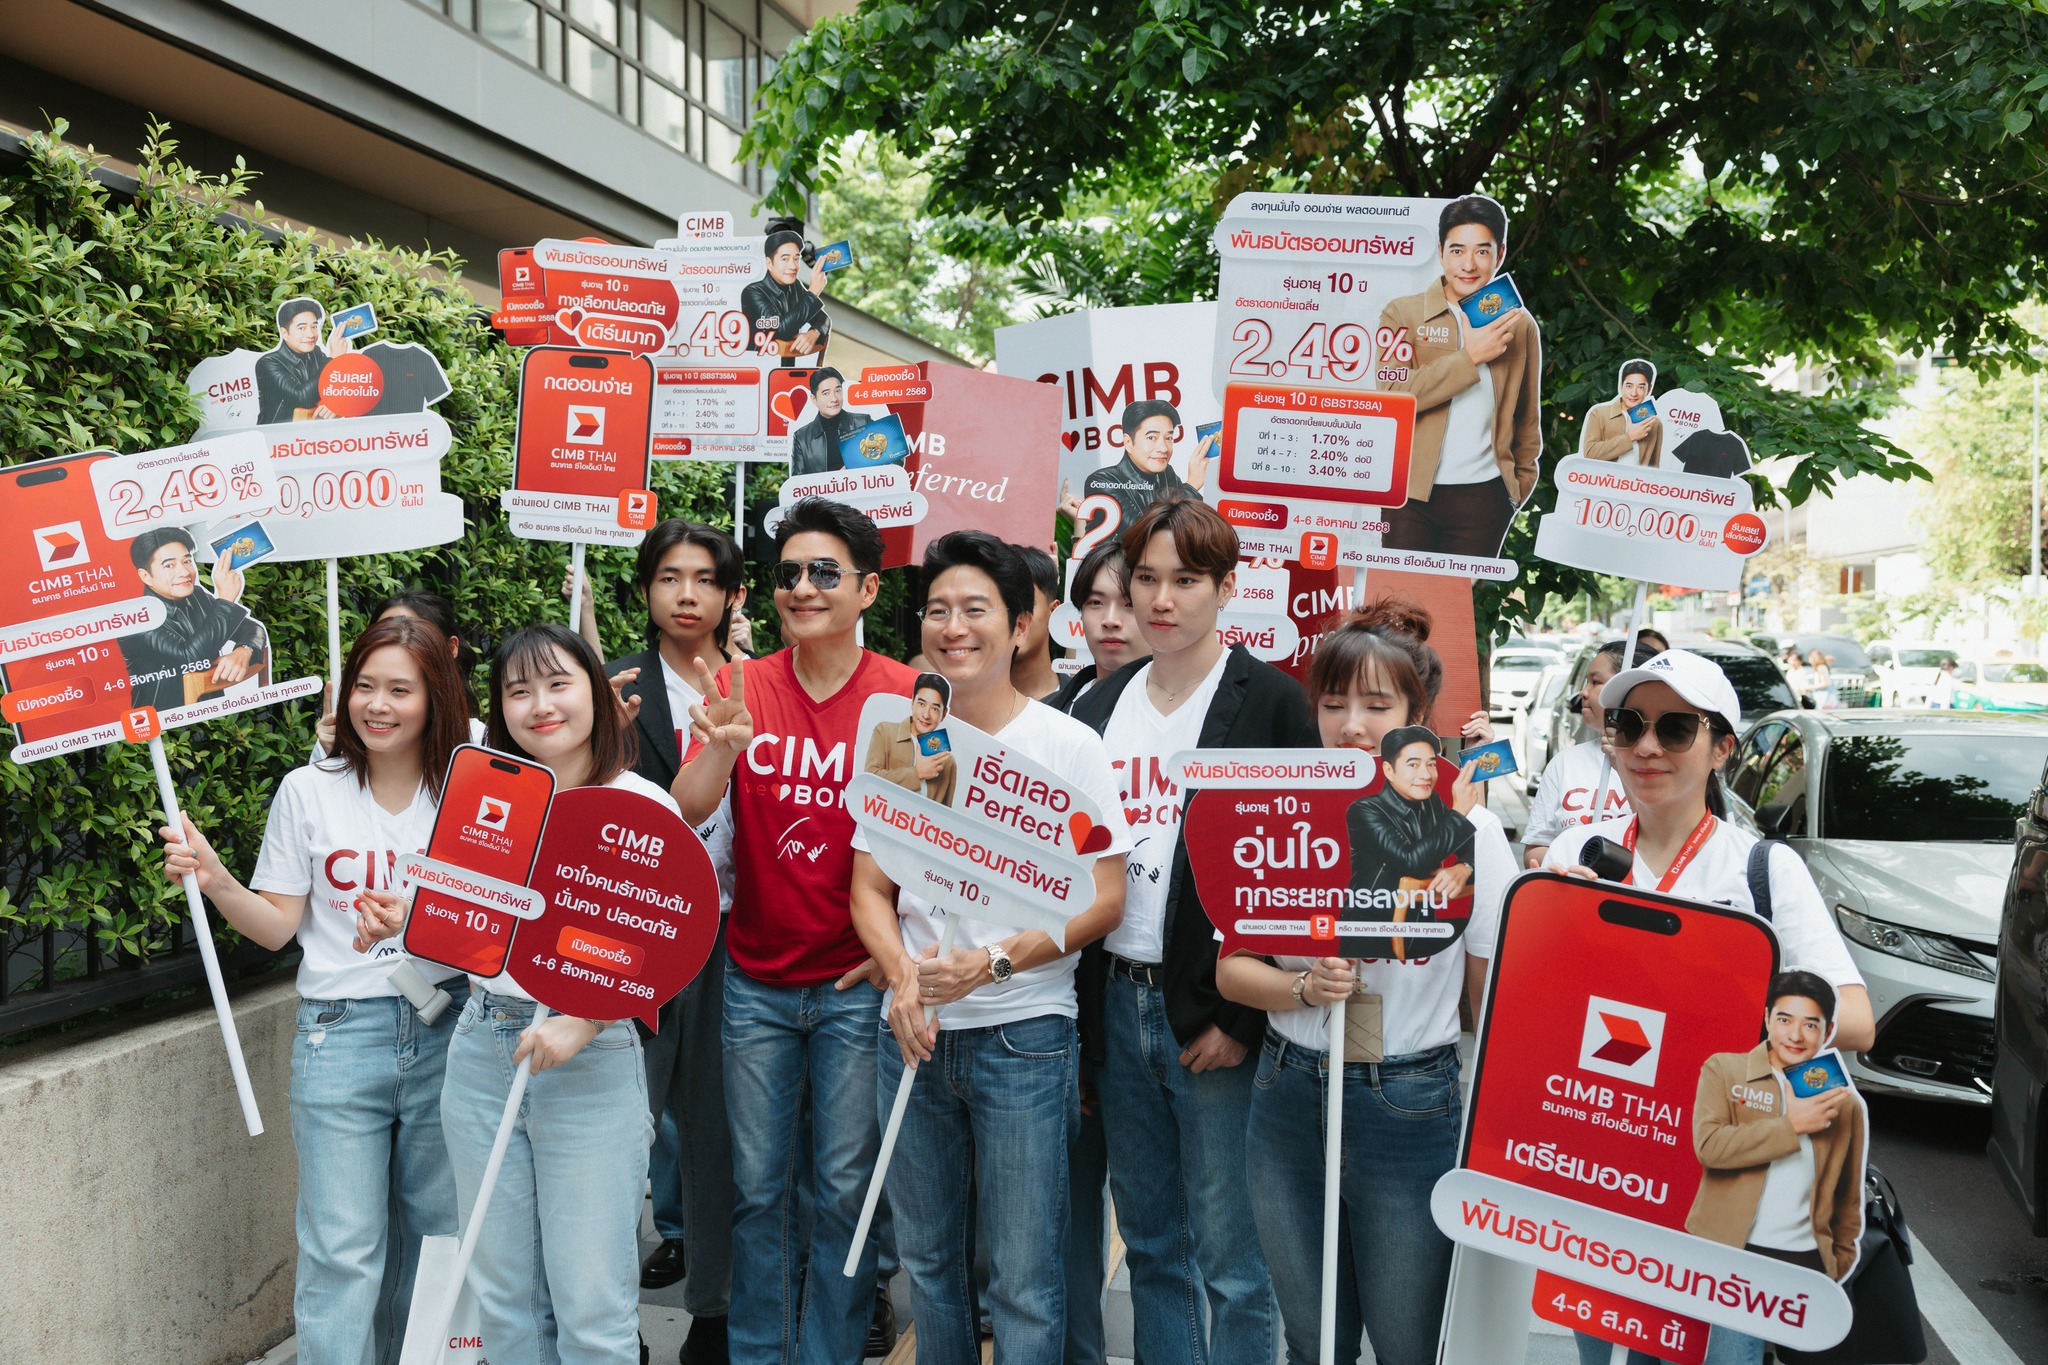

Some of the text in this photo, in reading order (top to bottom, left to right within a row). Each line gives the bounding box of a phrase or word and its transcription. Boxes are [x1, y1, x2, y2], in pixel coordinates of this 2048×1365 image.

[1251, 200, 1410, 217] ลงทุนมั่นใจ ออมง่าย ผลตอบแทนดี
[686, 217, 724, 231] CIMB
[1231, 229, 1414, 256] พันธบัตรออมทรัพย์
[546, 248, 668, 273] พันธบัตรออมทรัพย์
[606, 279, 621, 292] 10
[702, 283, 714, 293] 10
[1283, 272, 1368, 293] รุ่นอายุ 10 ปี
[558, 294, 666, 316] ทางเลือกปลอดภัย
[1235, 297, 1319, 311] อัตราดอกเบี้ยเฉลี่ย
[586, 323, 657, 347] เดิร์นมาก
[656, 310, 779, 358] .49 %
[1416, 325, 1450, 338] CIMB
[1428, 336, 1449, 344] BOND
[1229, 318, 1413, 383] 2.49 %
[329, 370, 373, 385] รับเลย!
[544, 376, 632, 395] กดออมง่าย
[867, 369, 915, 384] เปิดจองซื้อ
[1377, 366, 1408, 383] ต่อปี
[208, 376, 251, 399] CIMB
[227, 390, 253, 403] BOND
[322, 385, 379, 398] เสื้อก้องในใจ
[854, 387, 927, 399] 4-6 สิงหาคม 2568
[1036, 361, 1182, 420] IMB
[1253, 391, 1382, 412] รุ่นอายุ 10 (SBST358A)
[1669, 408, 1701, 423] CIMB
[1679, 421, 1699, 429] BOND
[1312, 433, 1374, 448] 1.70% ต่อปี
[137, 449, 210, 471] อัตราดอกเบี้ยเฉลี่ย
[551, 447, 616, 463] CIMB THAI
[1310, 449, 1372, 464] 2.40% ต่อปี
[231, 461, 255, 475] ต่อปี
[1308, 464, 1371, 480] 3.40% ต่อปี
[109, 464, 262, 527] 2.49 %
[400, 483, 423, 495] บาท
[792, 474, 895, 499] ลงทุนมั่นใจ ไปกับ
[1568, 471, 1736, 507] ออมพันธบัตรออมทรัพย์
[401, 497, 424, 508] ขึ้นไป
[512, 497, 610, 513] ผ่านแอป CIMB THAI
[1227, 506, 1390, 533] เปิดจองซื้อ 4-6 สิงหาคม 2568
[1574, 498, 1701, 544] 100,000
[1700, 529, 1718, 539] บาท
[1238, 541, 1293, 554] CIMB THAI
[1342, 550, 1506, 576] หรือ ธนาคาร ซีไอเอ็มบี ไทย ทุกสาขา
[28, 565, 114, 595] CIMB THAI
[32, 592, 61, 605] ธนาคาร
[1243, 587, 1274, 600] 2568
[45, 646, 99, 672] รุ่นอายุ 10
[17, 658, 212, 714] เปิดจองซื้อ 4-6 สิงหาคม 2568
[164, 712, 184, 724] หรือ
[187, 704, 219, 719] ธนาคาร
[261, 689, 278, 702] ไทย
[281, 681, 312, 698] ทุกสาขา
[21, 728, 117, 759] ผ่านแอป CIMB THAI
[746, 732, 857, 782] CIM
[1183, 760, 1355, 779] พันธบัตรออมทรัพย์
[973, 751, 1071, 813] เริ่ดเลอ
[965, 785, 1065, 846] Perfect
[1235, 796, 1310, 816] รุ่นอายุ 10 ปี
[462, 825, 513, 848] CIMB THAI
[601, 823, 665, 858] CIMB
[621, 849, 660, 869] BOND
[864, 794, 1072, 902] พันธบัตรออมทรัพย์
[1233, 821, 1340, 880] อุ่นใจ
[406, 863, 531, 912] พันธบัตรออมทรัพย์
[556, 863, 692, 915] เอาใจคนรักเงินต้น
[924, 869, 980, 902] รุ่นอายุ 10
[328, 897, 349, 912] we
[1235, 886, 1449, 916] ทุกระยะการลงทุน
[425, 902, 488, 932] รุ่นอายุ 10
[554, 888, 678, 940] มั่นคง ปลอดภัย
[571, 937, 632, 966] เปิดจองซื้อ
[532, 953, 655, 1000] 4-6 สิงหาคม 2568
[1545, 1073, 1682, 1129] CIMB THAI
[1731, 1084, 1774, 1106] CIMB
[1746, 1100, 1773, 1113] BOND
[1542, 1099, 1678, 1147] ธนาคาร ซีไอเอ็มบี ไทย
[1505, 1137, 1669, 1206] เตรียมออม
[1461, 1196, 1810, 1330] พันธบัตรออมทรัพย์
[1551, 1291, 1687, 1352] 4-6 ส.ค. นี้!
